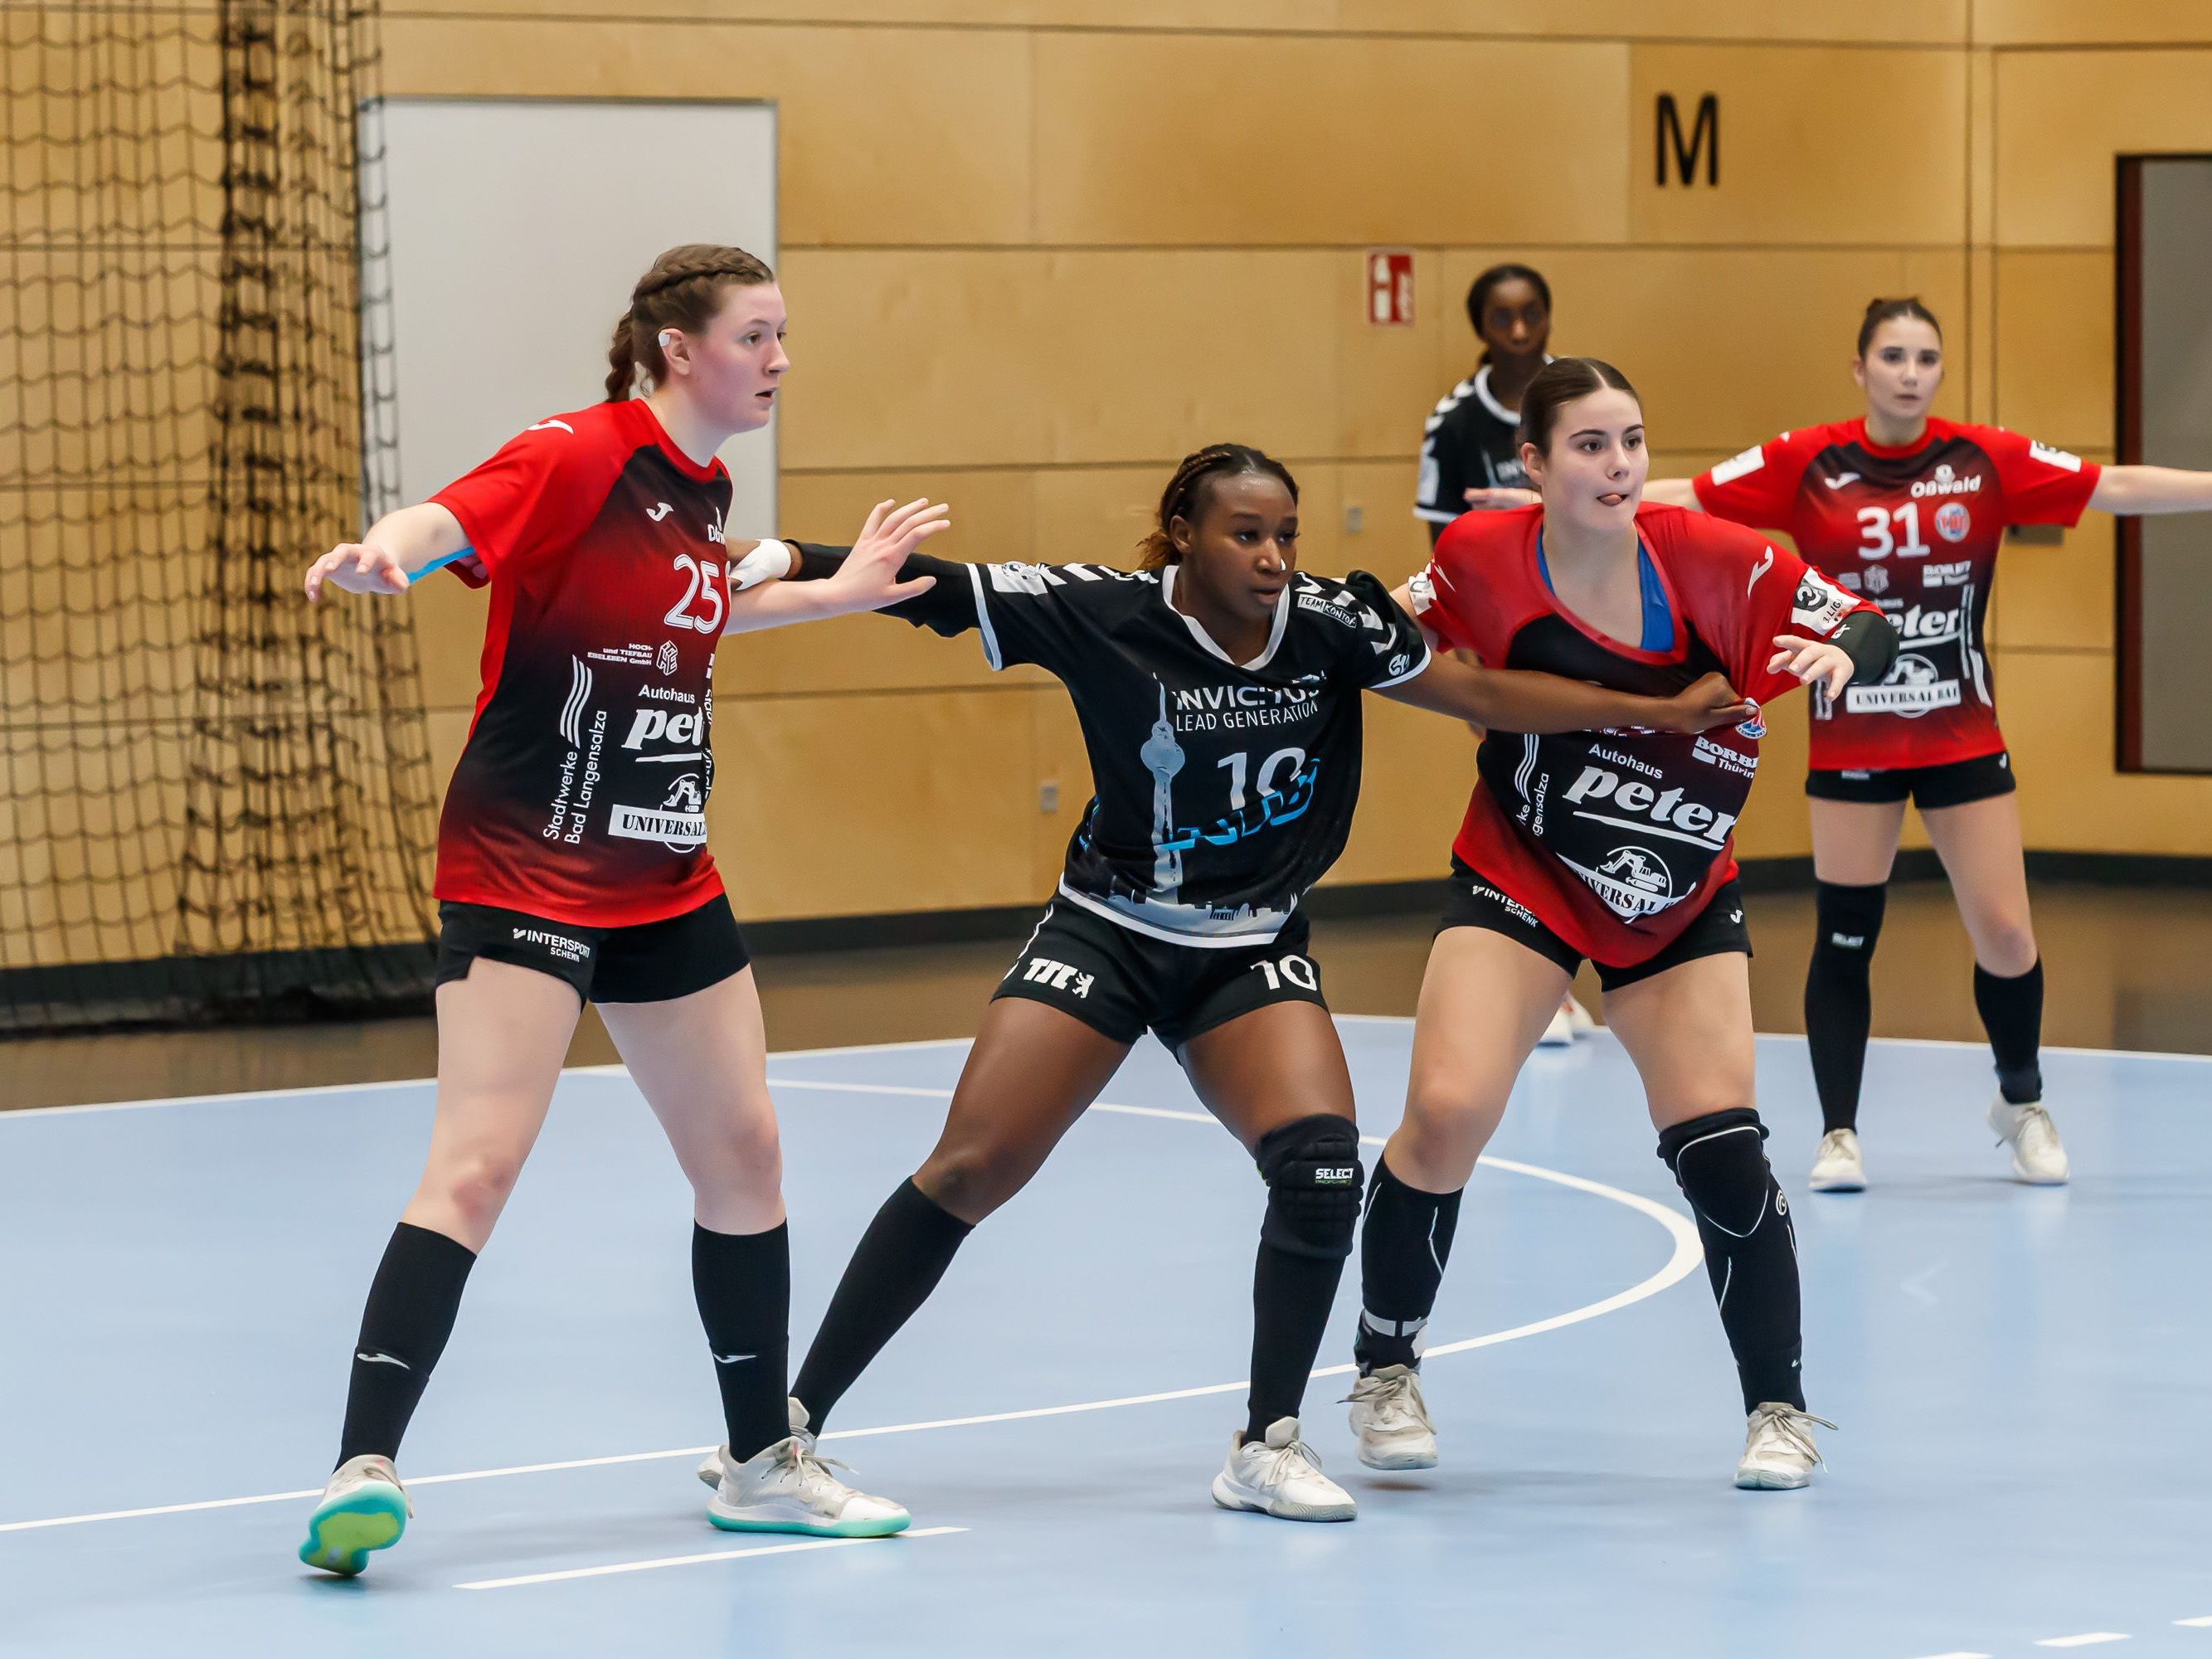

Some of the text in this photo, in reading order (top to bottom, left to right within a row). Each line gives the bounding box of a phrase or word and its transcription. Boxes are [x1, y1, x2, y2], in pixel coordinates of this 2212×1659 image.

[1656, 93, 1719, 187] M
[1856, 501, 1931, 561] 31
[664, 553, 724, 634] 25
[1300, 596, 1325, 610] TEAM
[638, 684, 696, 704] Autohaus
[1176, 700, 1319, 732] LEAD GENERATION
[564, 710, 607, 844] Bad Langensalza
[1588, 743, 1663, 780] Autohaus
[543, 751, 578, 840] Stadtwerke
[1562, 766, 1742, 844] peter
[1505, 906, 1539, 927] SCHENK
[527, 929, 591, 958] INTERSPORT
[1249, 955, 1317, 991] 10
[1315, 1168, 1354, 1179] SELECT
